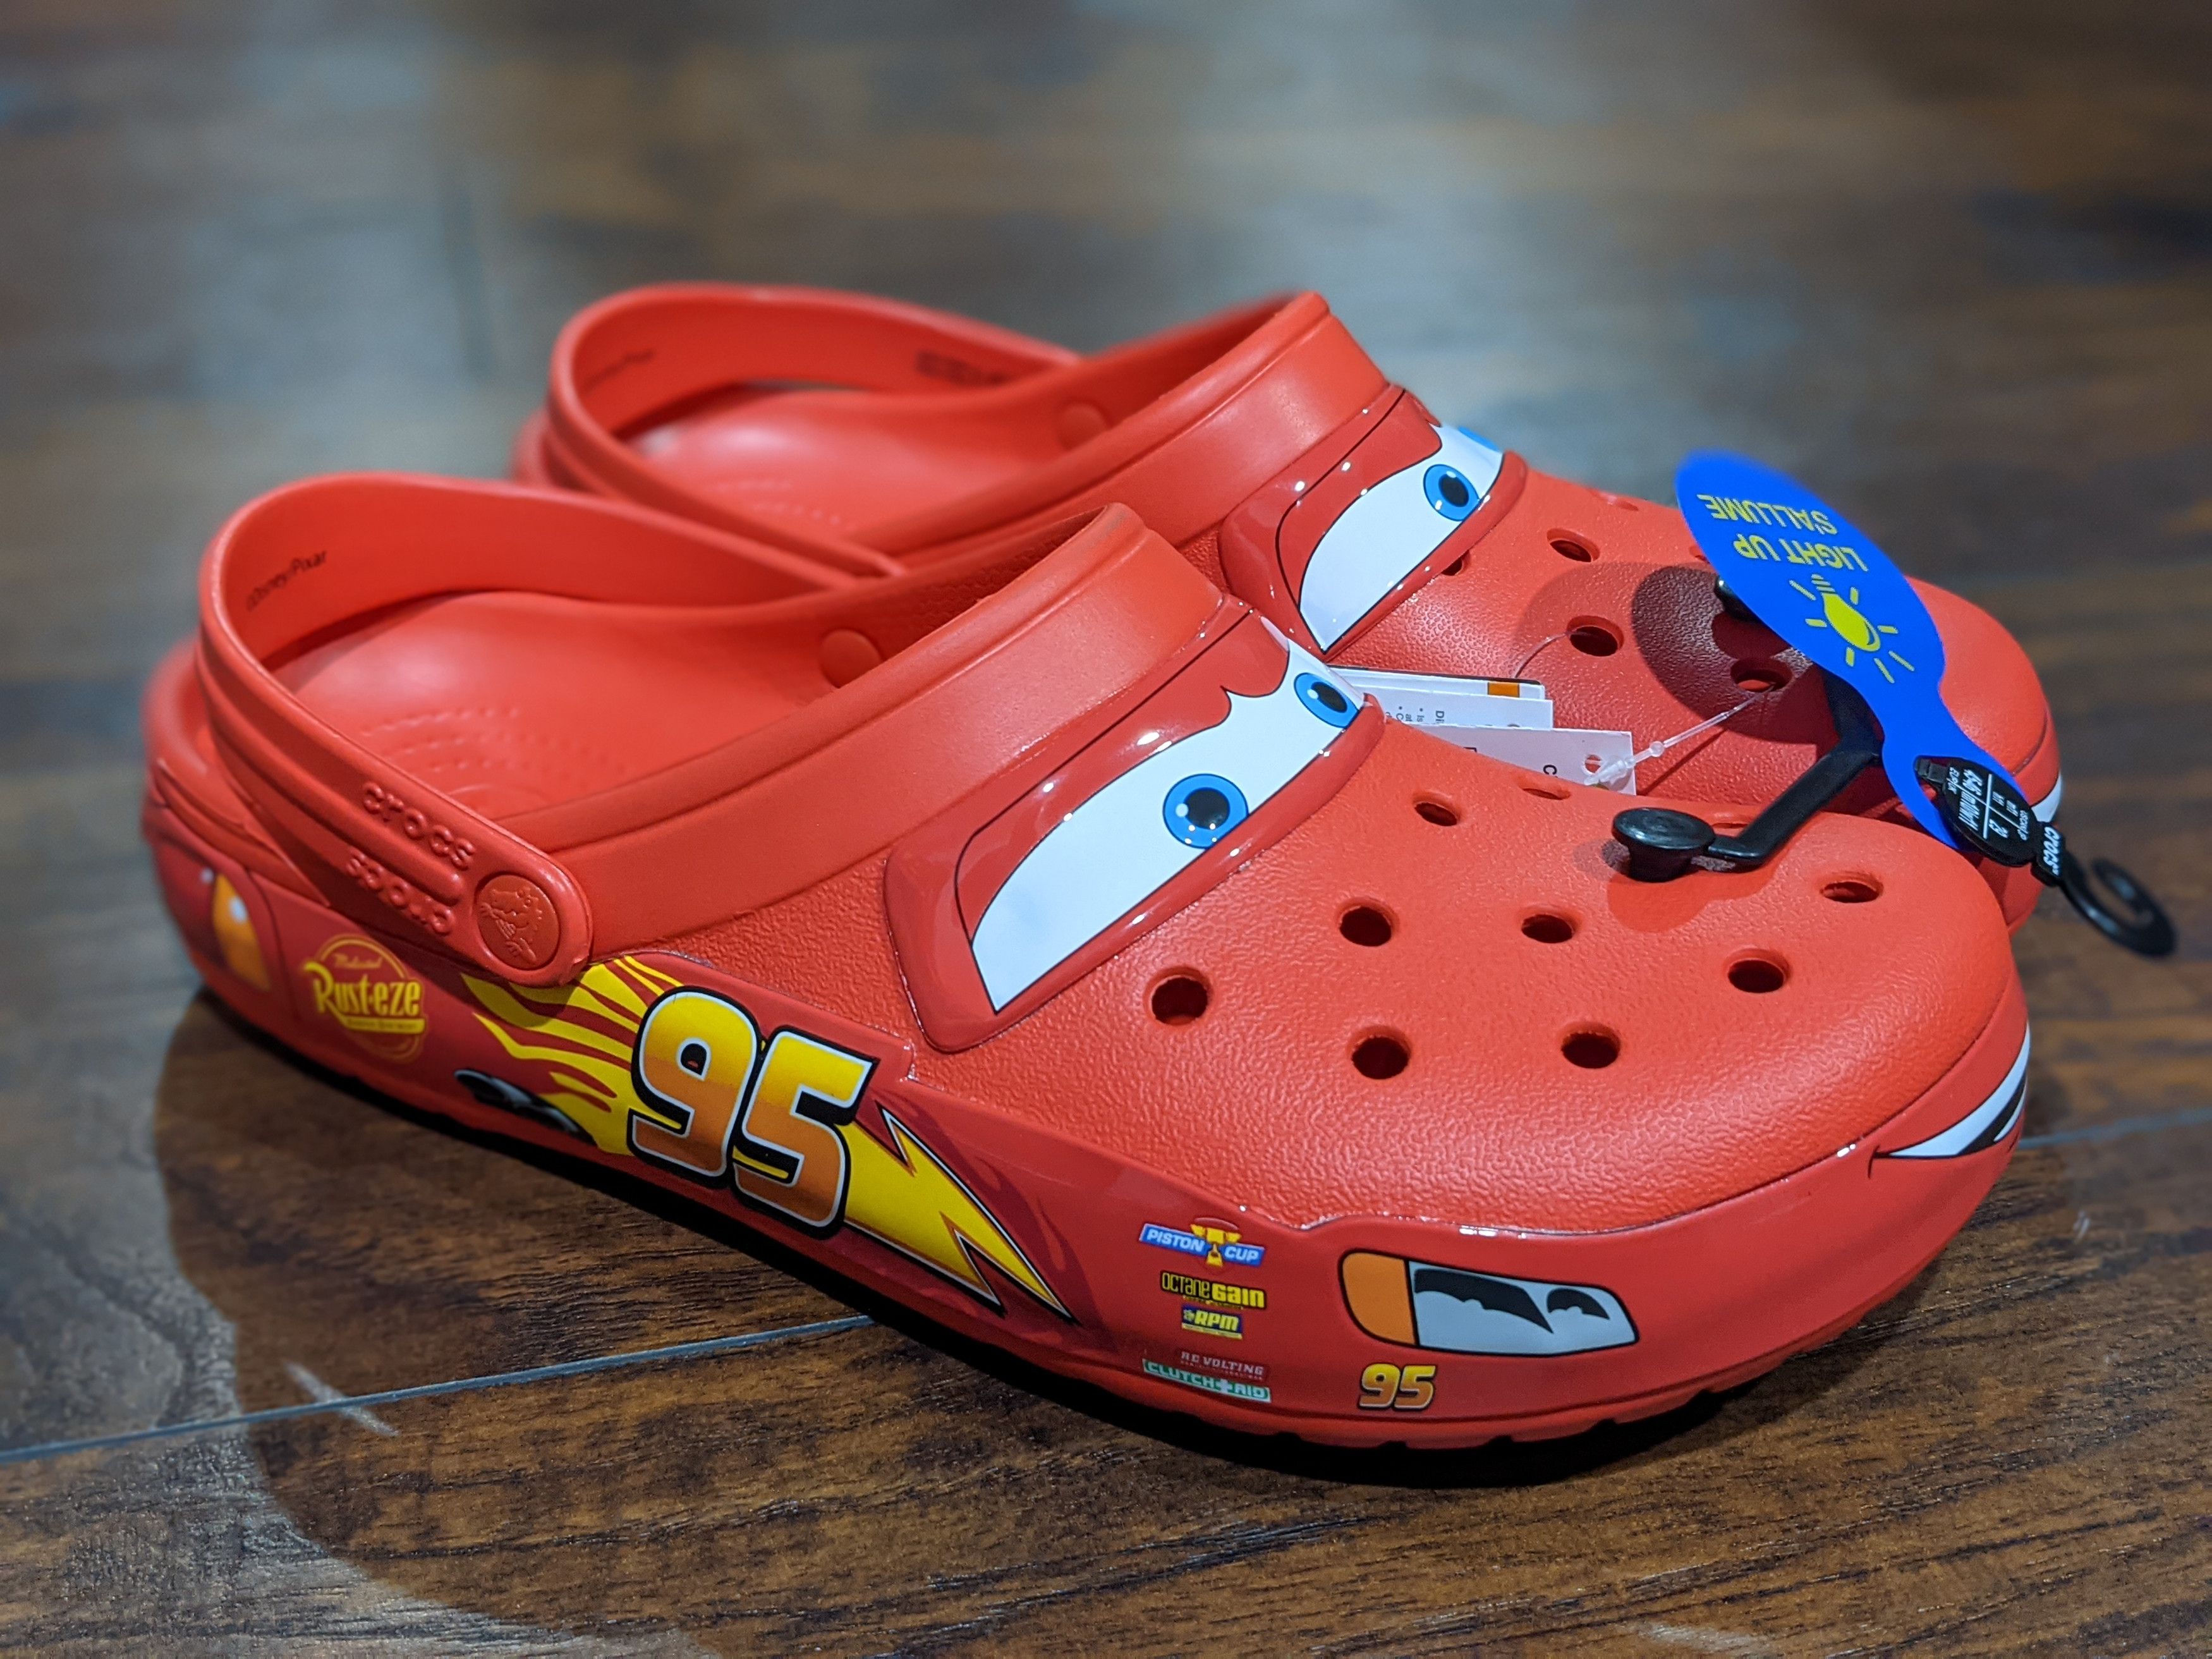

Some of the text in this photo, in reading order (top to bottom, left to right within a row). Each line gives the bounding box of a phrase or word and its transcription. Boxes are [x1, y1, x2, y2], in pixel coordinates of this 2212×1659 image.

[1733, 533, 1868, 571] LIGHT UP
[363, 781, 476, 871] crocs
[2043, 826, 2061, 872] crocs
[346, 848, 455, 935] crocs
[627, 986, 880, 1240] 95
[1146, 1228, 1260, 1262] PISTON CUP
[1147, 1361, 1215, 1388] CLUTCH
[1358, 1363, 1438, 1412] 95
